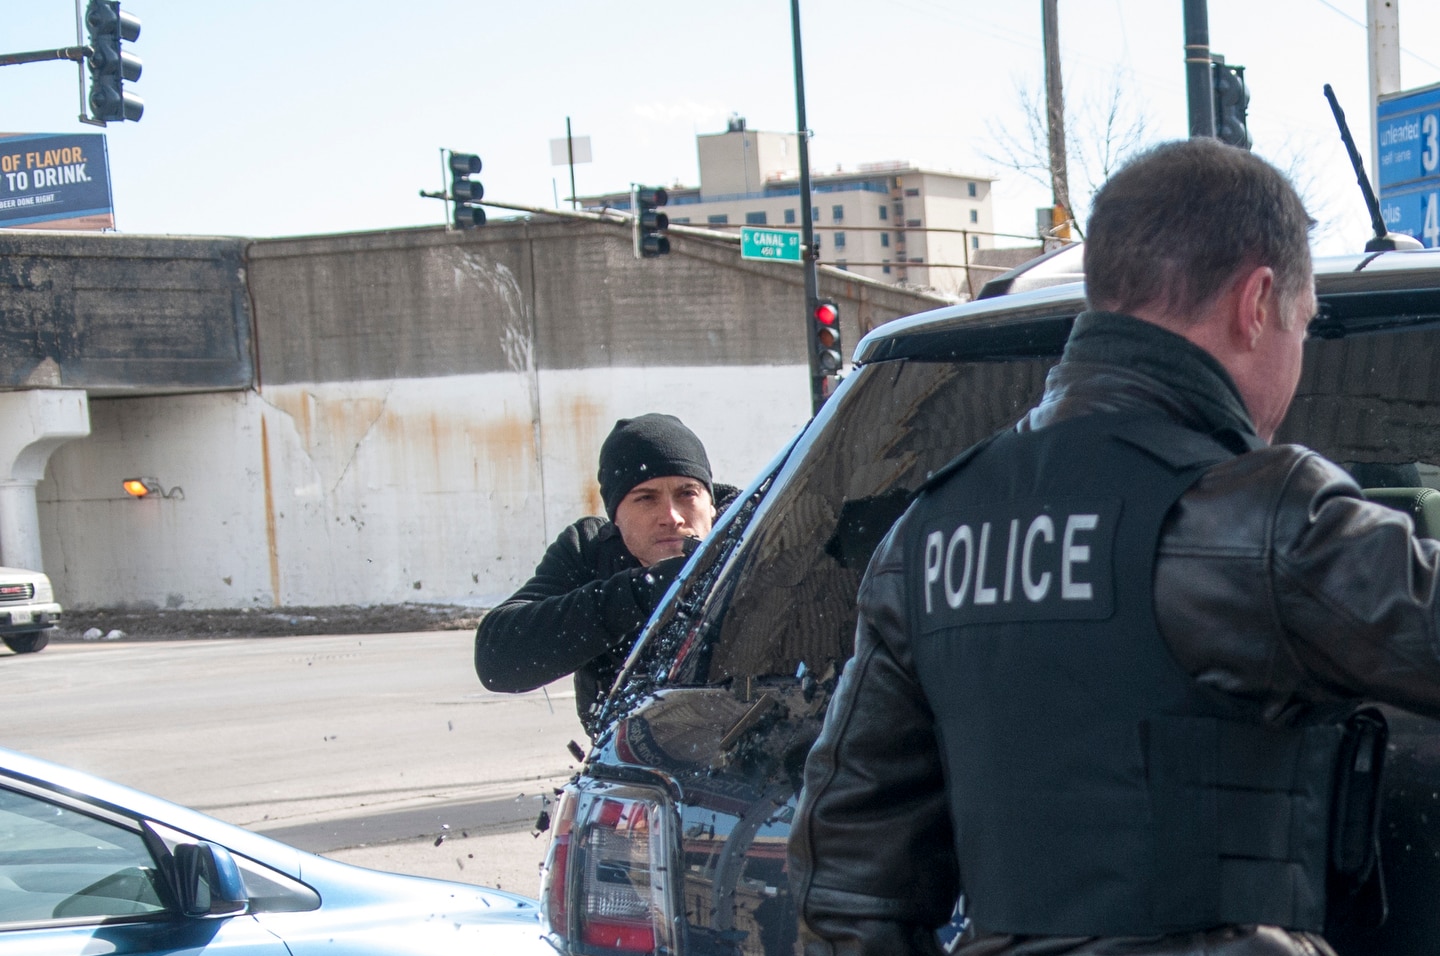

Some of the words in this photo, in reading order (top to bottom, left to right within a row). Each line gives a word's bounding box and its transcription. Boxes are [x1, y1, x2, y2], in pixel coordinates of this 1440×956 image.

[1381, 118, 1419, 147] unleaded
[1, 154, 21, 172] OF
[26, 146, 88, 169] FLAVOR.
[6, 171, 28, 192] TO
[33, 163, 92, 189] DRINK.
[17, 196, 35, 207] DONE
[35, 194, 55, 204] RIGHT
[744, 233, 750, 243] S
[753, 232, 785, 247] CANAL
[789, 237, 797, 246] ST
[924, 514, 1099, 614] POLICE
